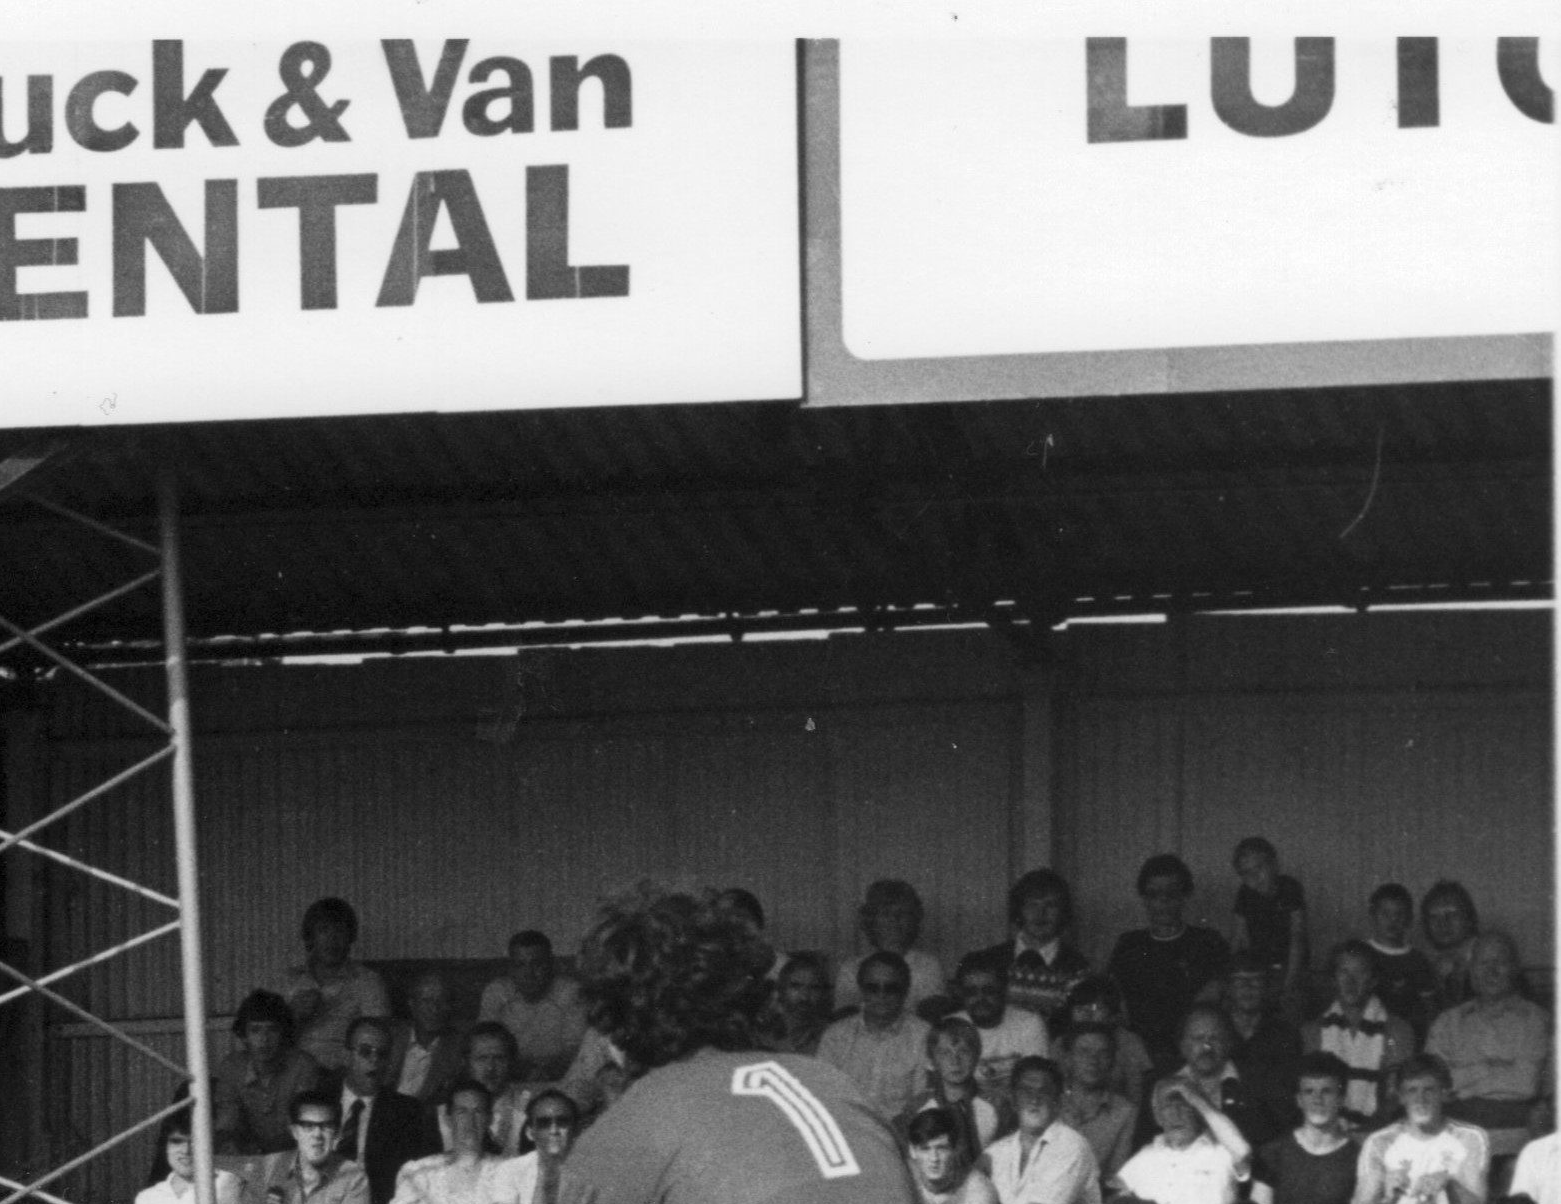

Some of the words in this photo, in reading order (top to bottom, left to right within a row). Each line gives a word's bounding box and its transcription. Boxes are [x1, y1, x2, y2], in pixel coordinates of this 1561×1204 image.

[263, 40, 353, 148] &
[380, 38, 633, 141] Van
[731, 1060, 861, 1179] 1
